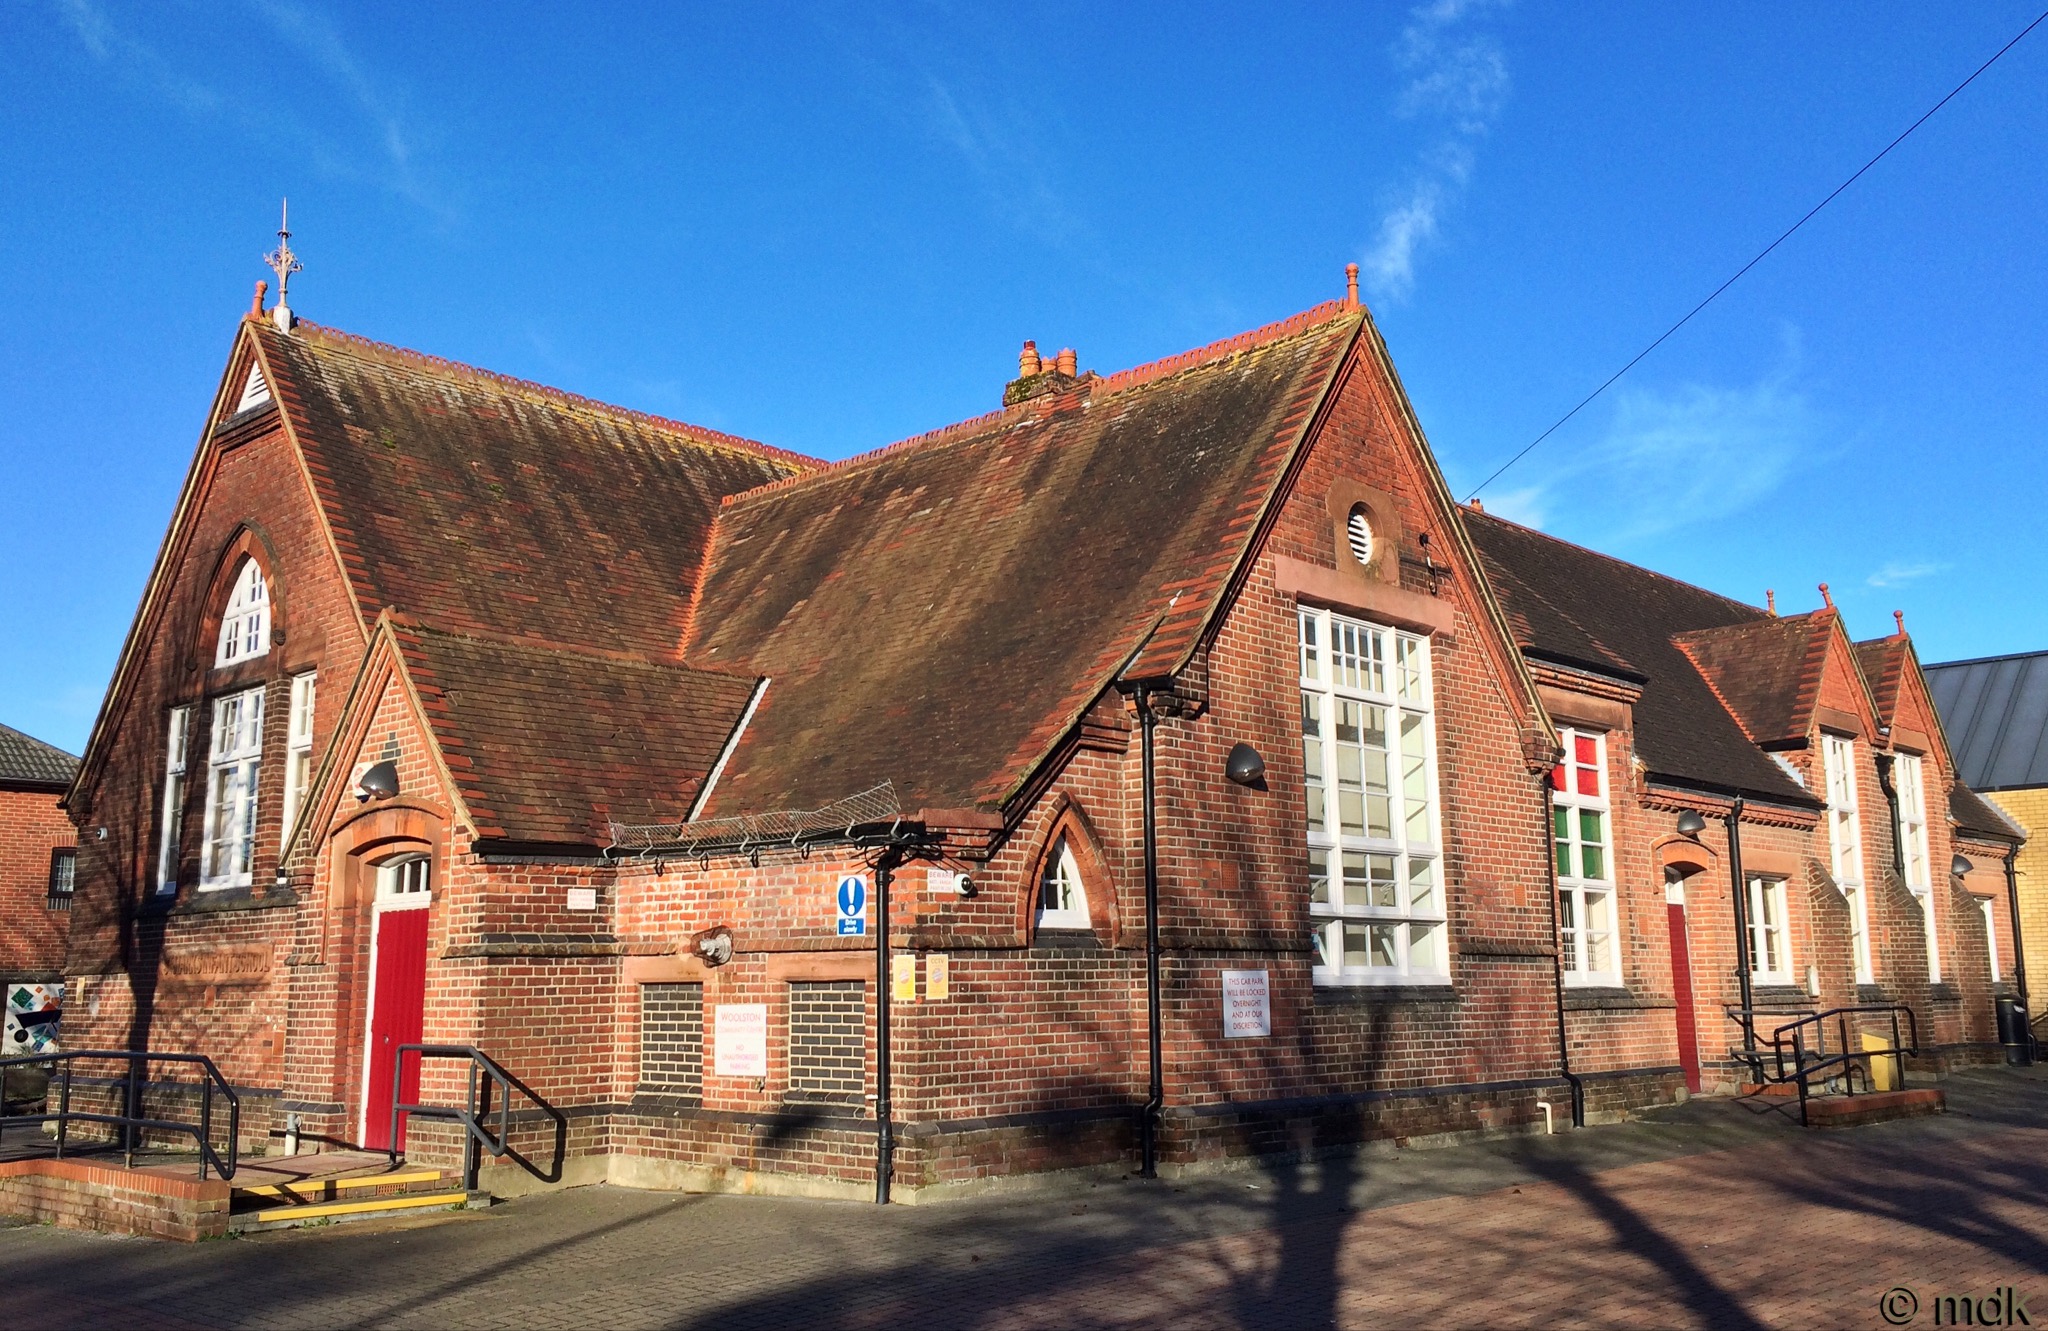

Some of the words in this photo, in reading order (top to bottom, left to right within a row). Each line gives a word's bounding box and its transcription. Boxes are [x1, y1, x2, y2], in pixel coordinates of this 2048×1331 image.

[845, 918, 857, 926] Drive
[1240, 977, 1251, 985] CAR
[1252, 977, 1264, 985] PARK
[1227, 989, 1239, 997] WILL
[1247, 988, 1266, 996] LOCKED
[721, 1012, 761, 1022] WOOLSTON
[1233, 1021, 1263, 1029] DISCRETION
[735, 1043, 745, 1051] NO
